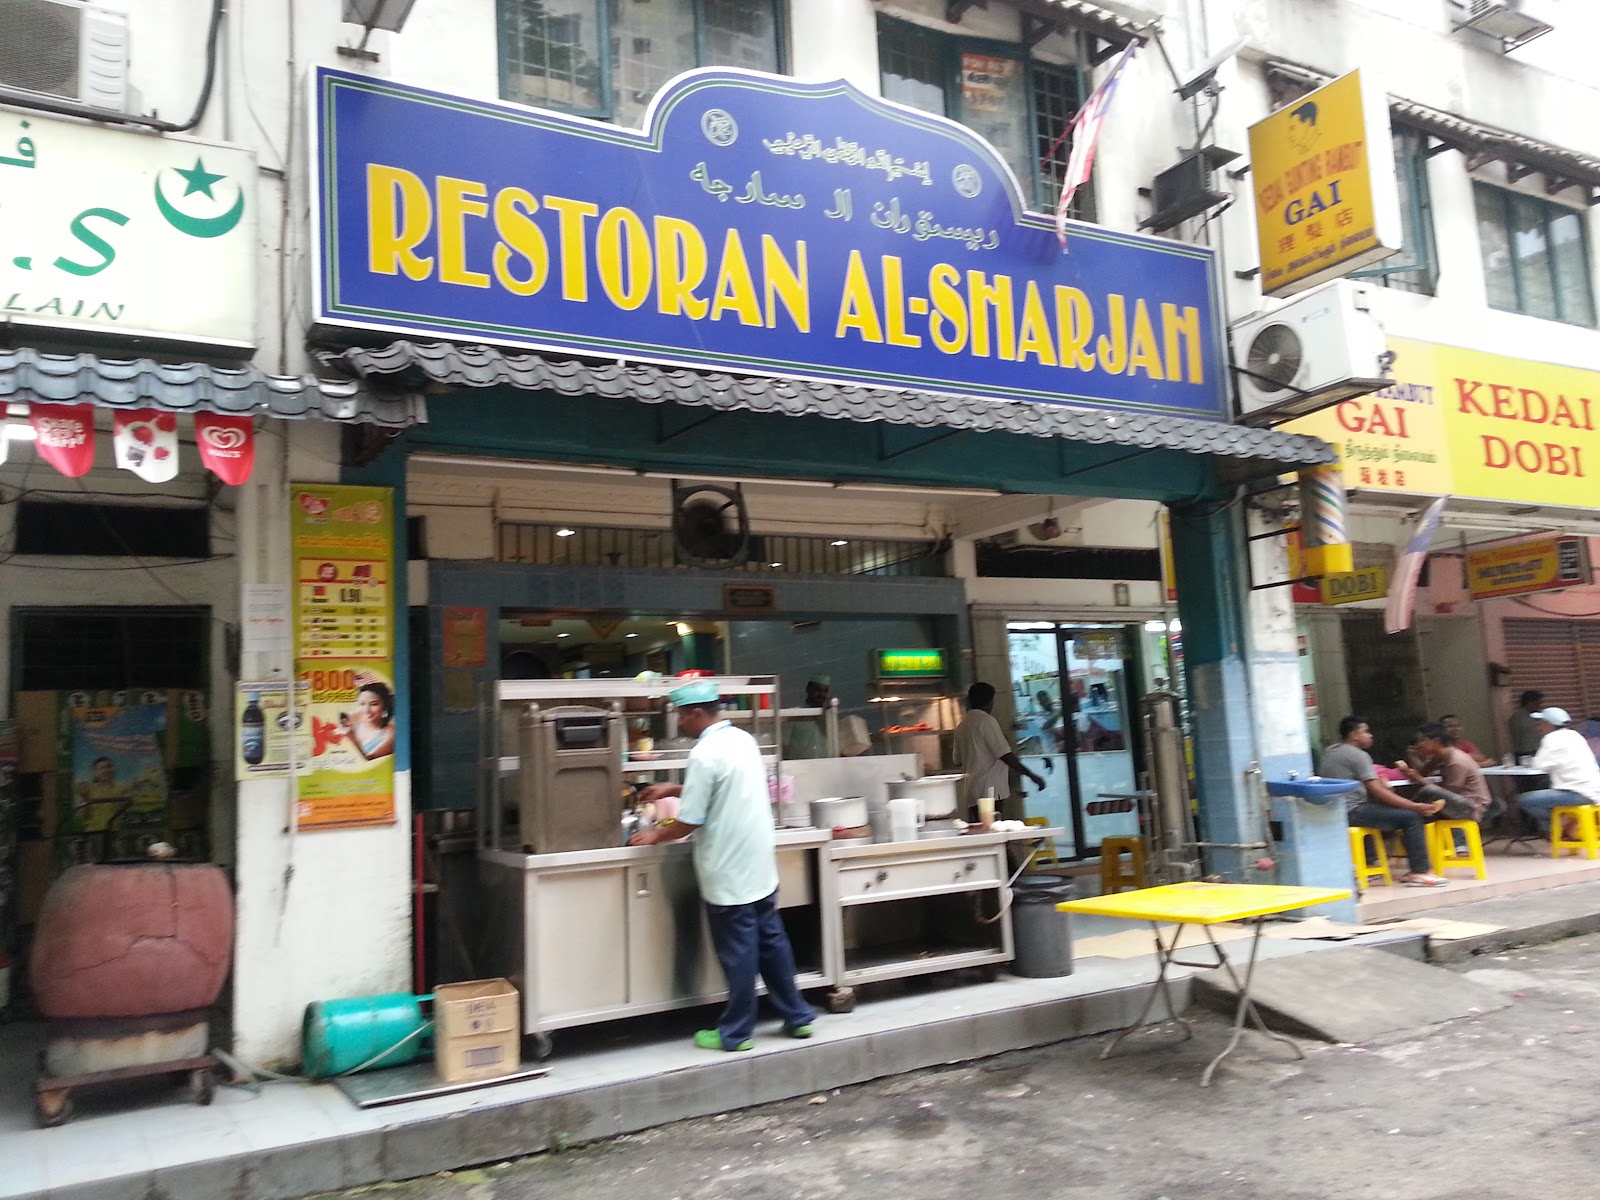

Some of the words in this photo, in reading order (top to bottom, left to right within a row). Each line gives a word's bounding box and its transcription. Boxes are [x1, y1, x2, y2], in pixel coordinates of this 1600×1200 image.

[1284, 179, 1343, 226] GAI
[367, 163, 811, 333] RESTORAN
[835, 250, 1203, 384] AL-SHARJAH
[1336, 400, 1410, 438] GAI
[1454, 378, 1595, 431] KEDAI
[1480, 435, 1585, 478] DOBI
[1329, 572, 1377, 597] DOBI
